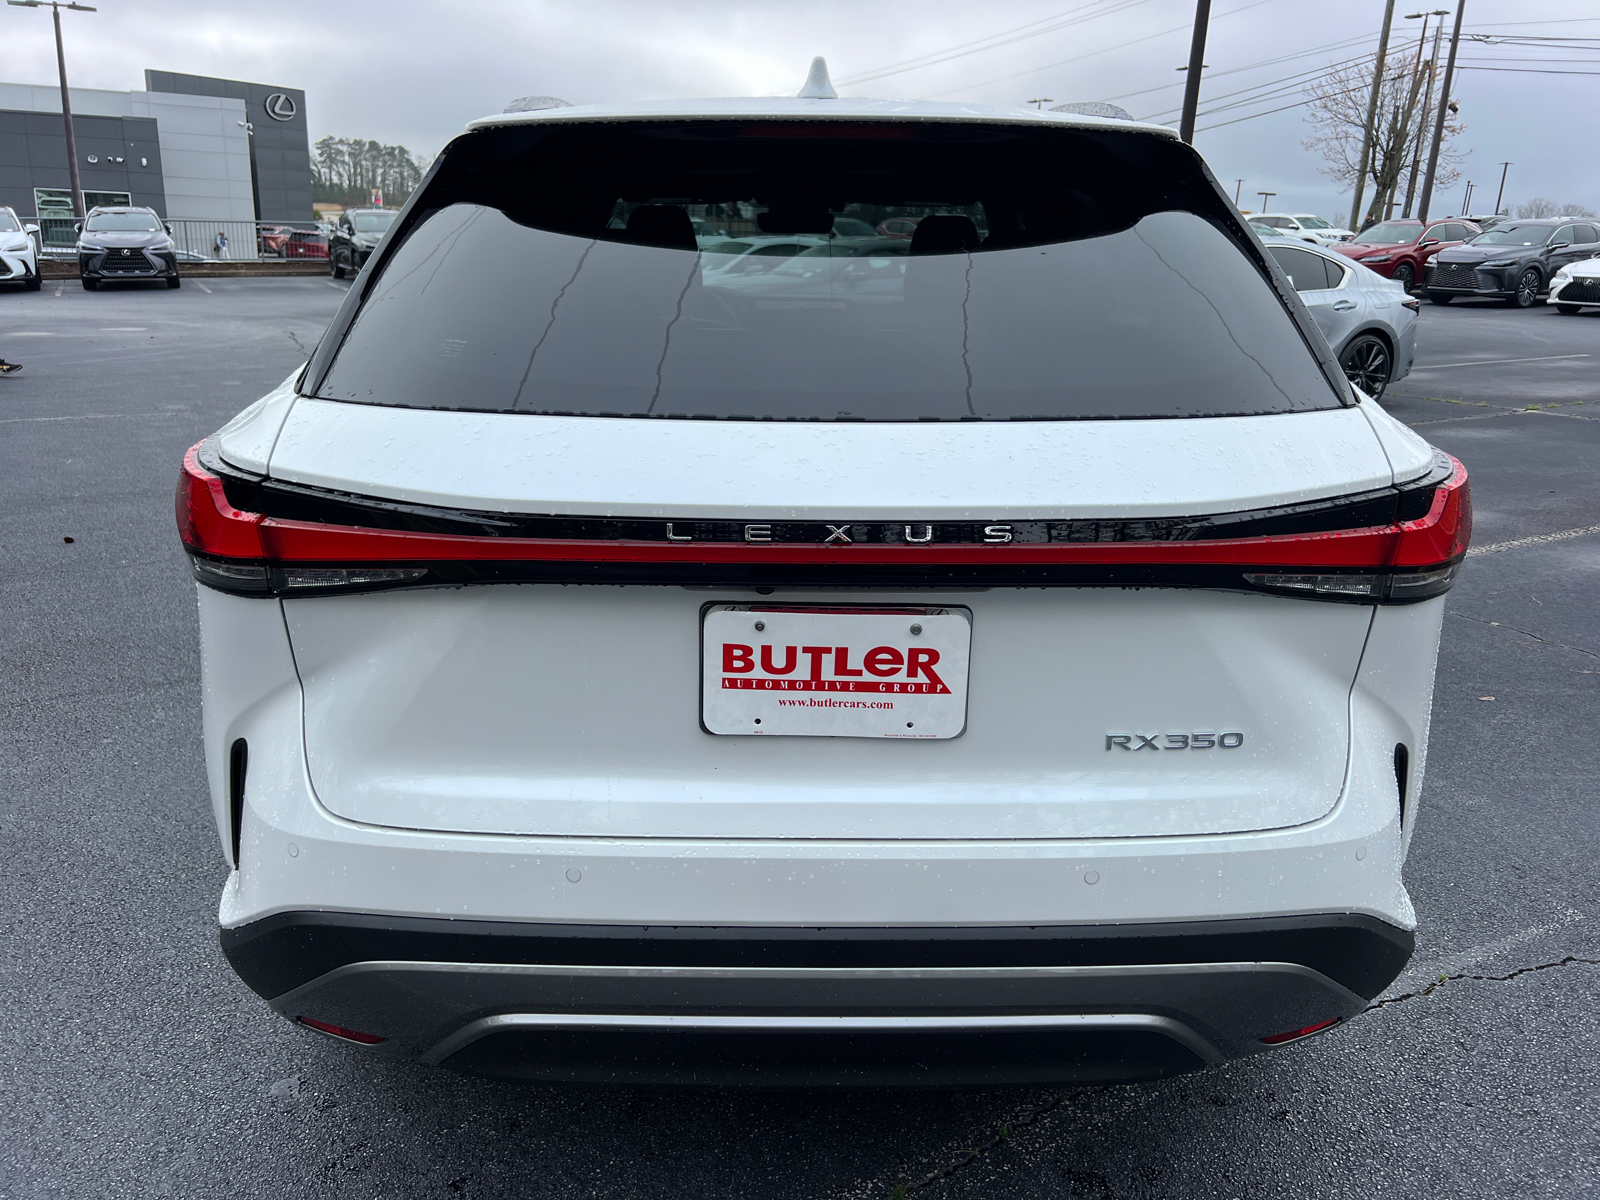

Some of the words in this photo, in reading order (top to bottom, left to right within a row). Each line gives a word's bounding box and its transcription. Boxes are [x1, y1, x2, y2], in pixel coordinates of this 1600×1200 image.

[666, 522, 1013, 543] LEXUS
[723, 678, 856, 691] AUTOMOTIVE
[879, 682, 945, 693] GROUP
[778, 697, 894, 710] www.butlercars.com
